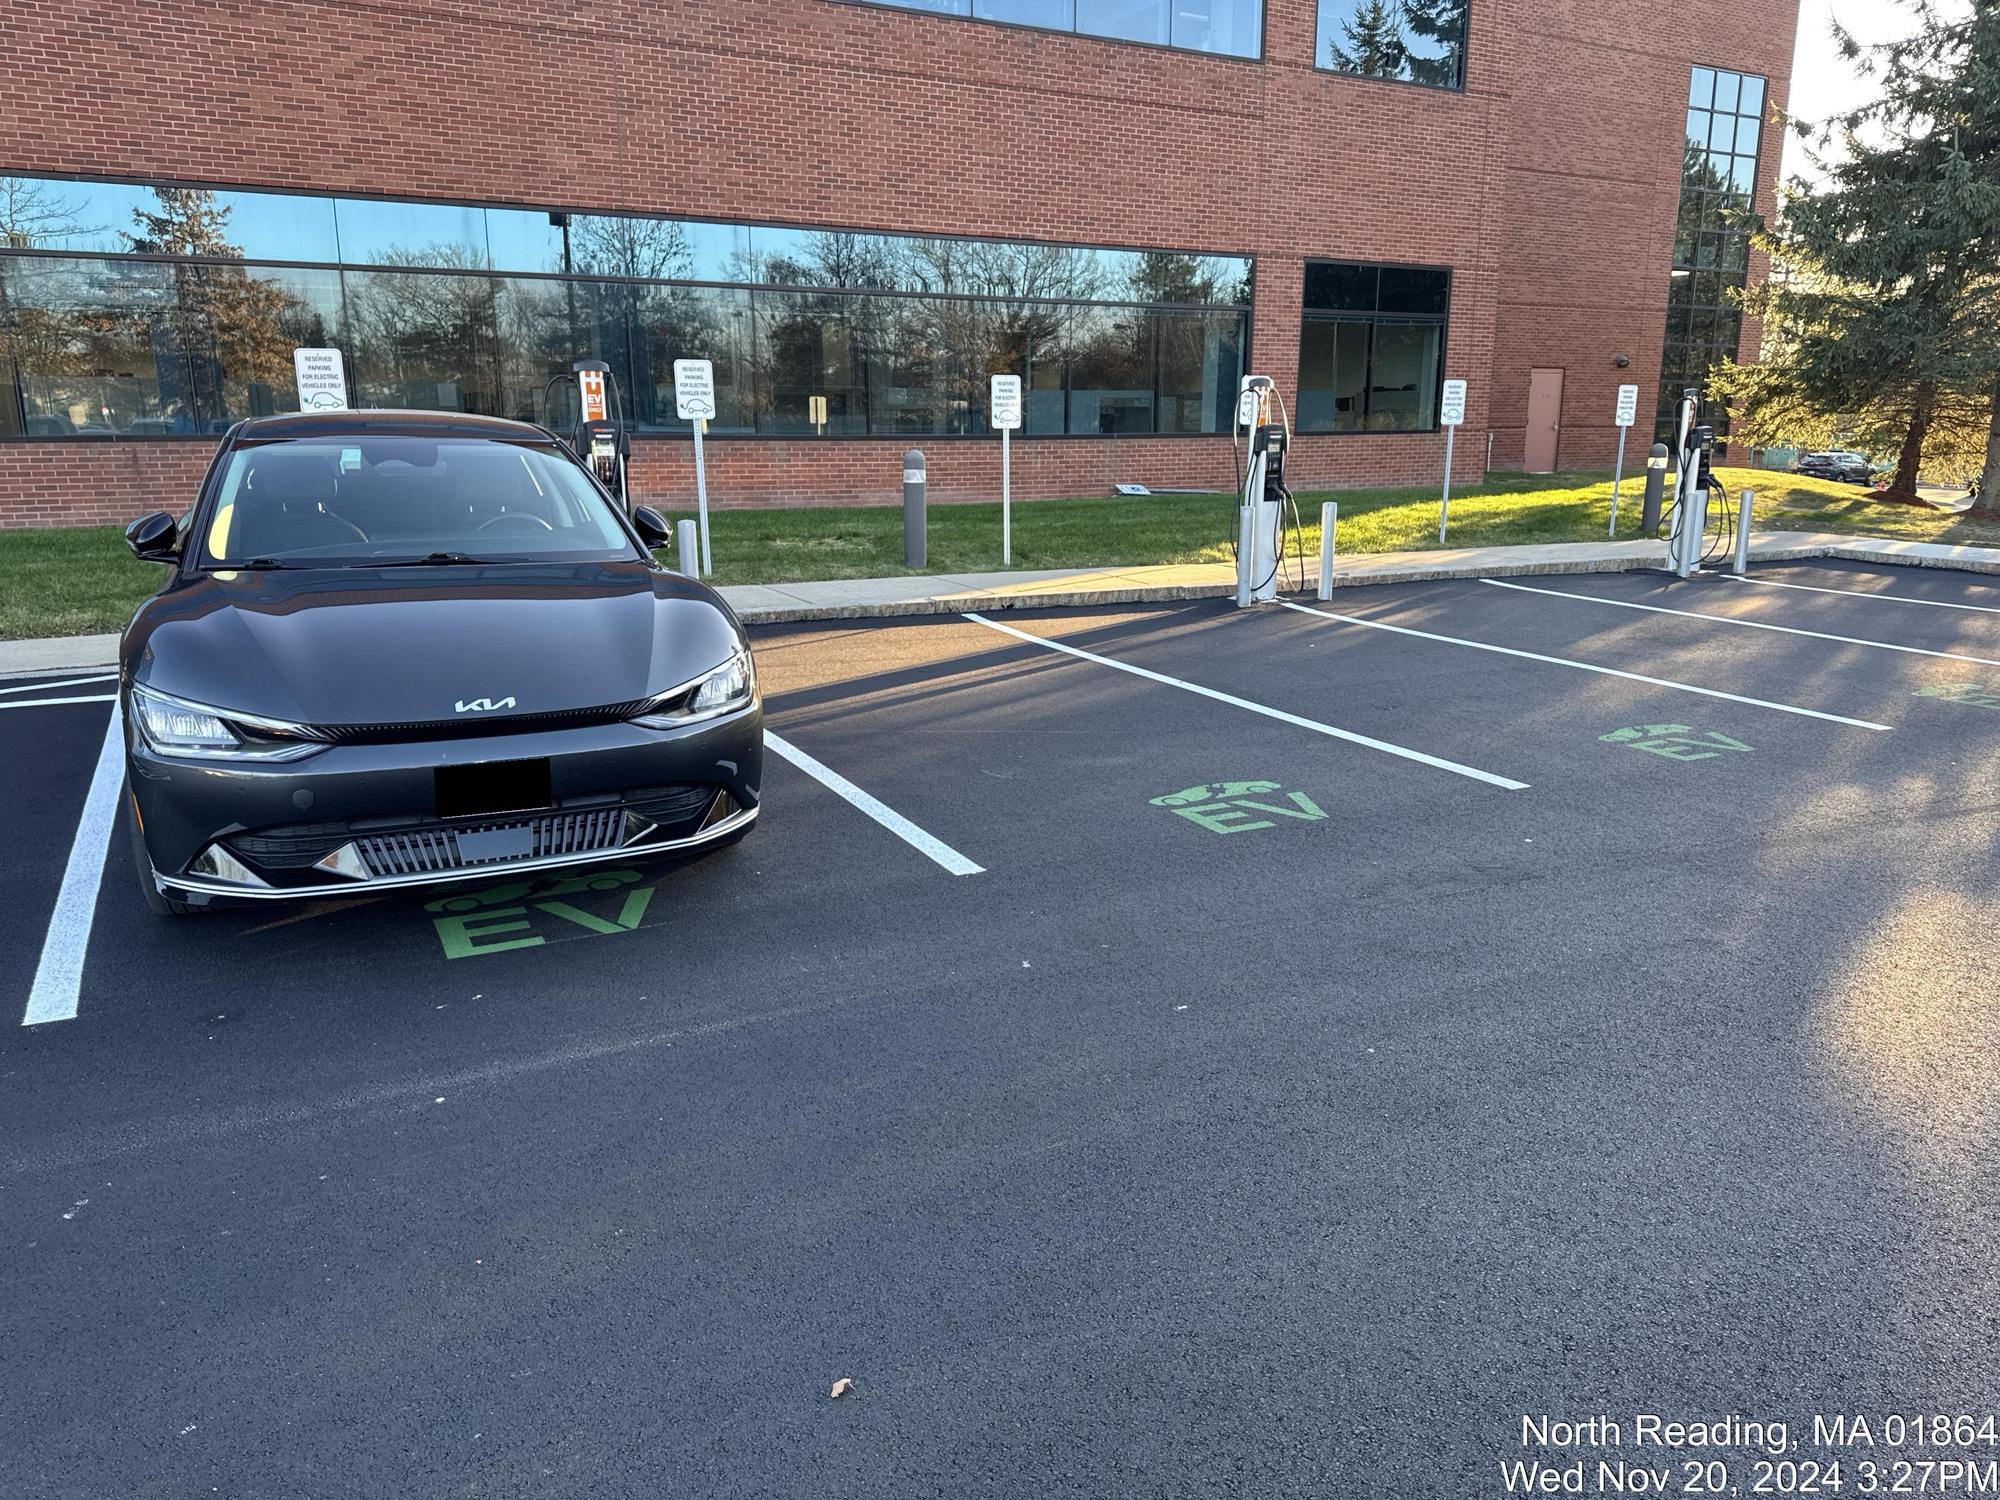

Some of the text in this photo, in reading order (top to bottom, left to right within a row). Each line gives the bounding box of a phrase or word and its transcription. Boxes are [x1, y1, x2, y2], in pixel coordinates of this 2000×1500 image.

[588, 394, 601, 404] EV
[1624, 731, 1757, 761] EV
[1170, 791, 1329, 834] EV
[433, 887, 656, 960] EV
